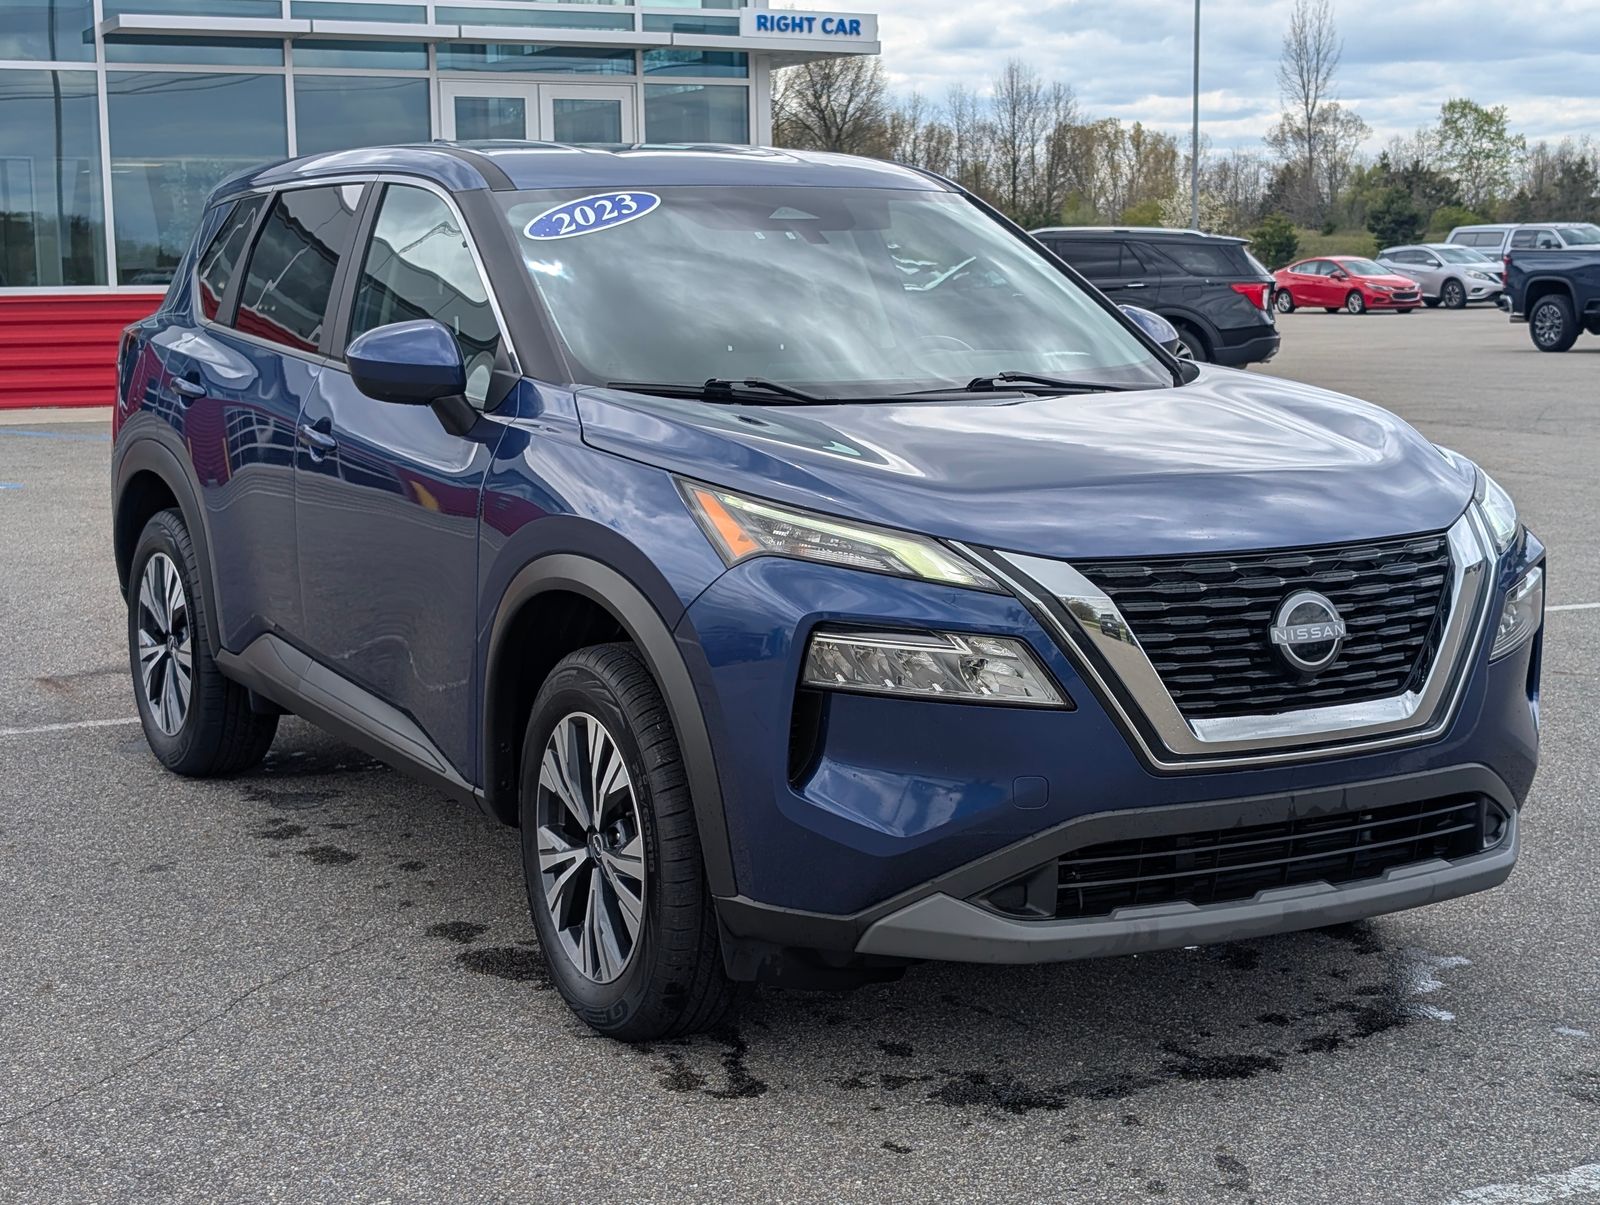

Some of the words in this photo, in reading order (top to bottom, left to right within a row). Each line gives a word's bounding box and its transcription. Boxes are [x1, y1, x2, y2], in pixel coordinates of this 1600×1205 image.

[756, 14, 817, 34] RIGHT
[821, 17, 861, 36] CAR
[551, 194, 638, 235] 2023
[1273, 623, 1345, 641] NISSAN
